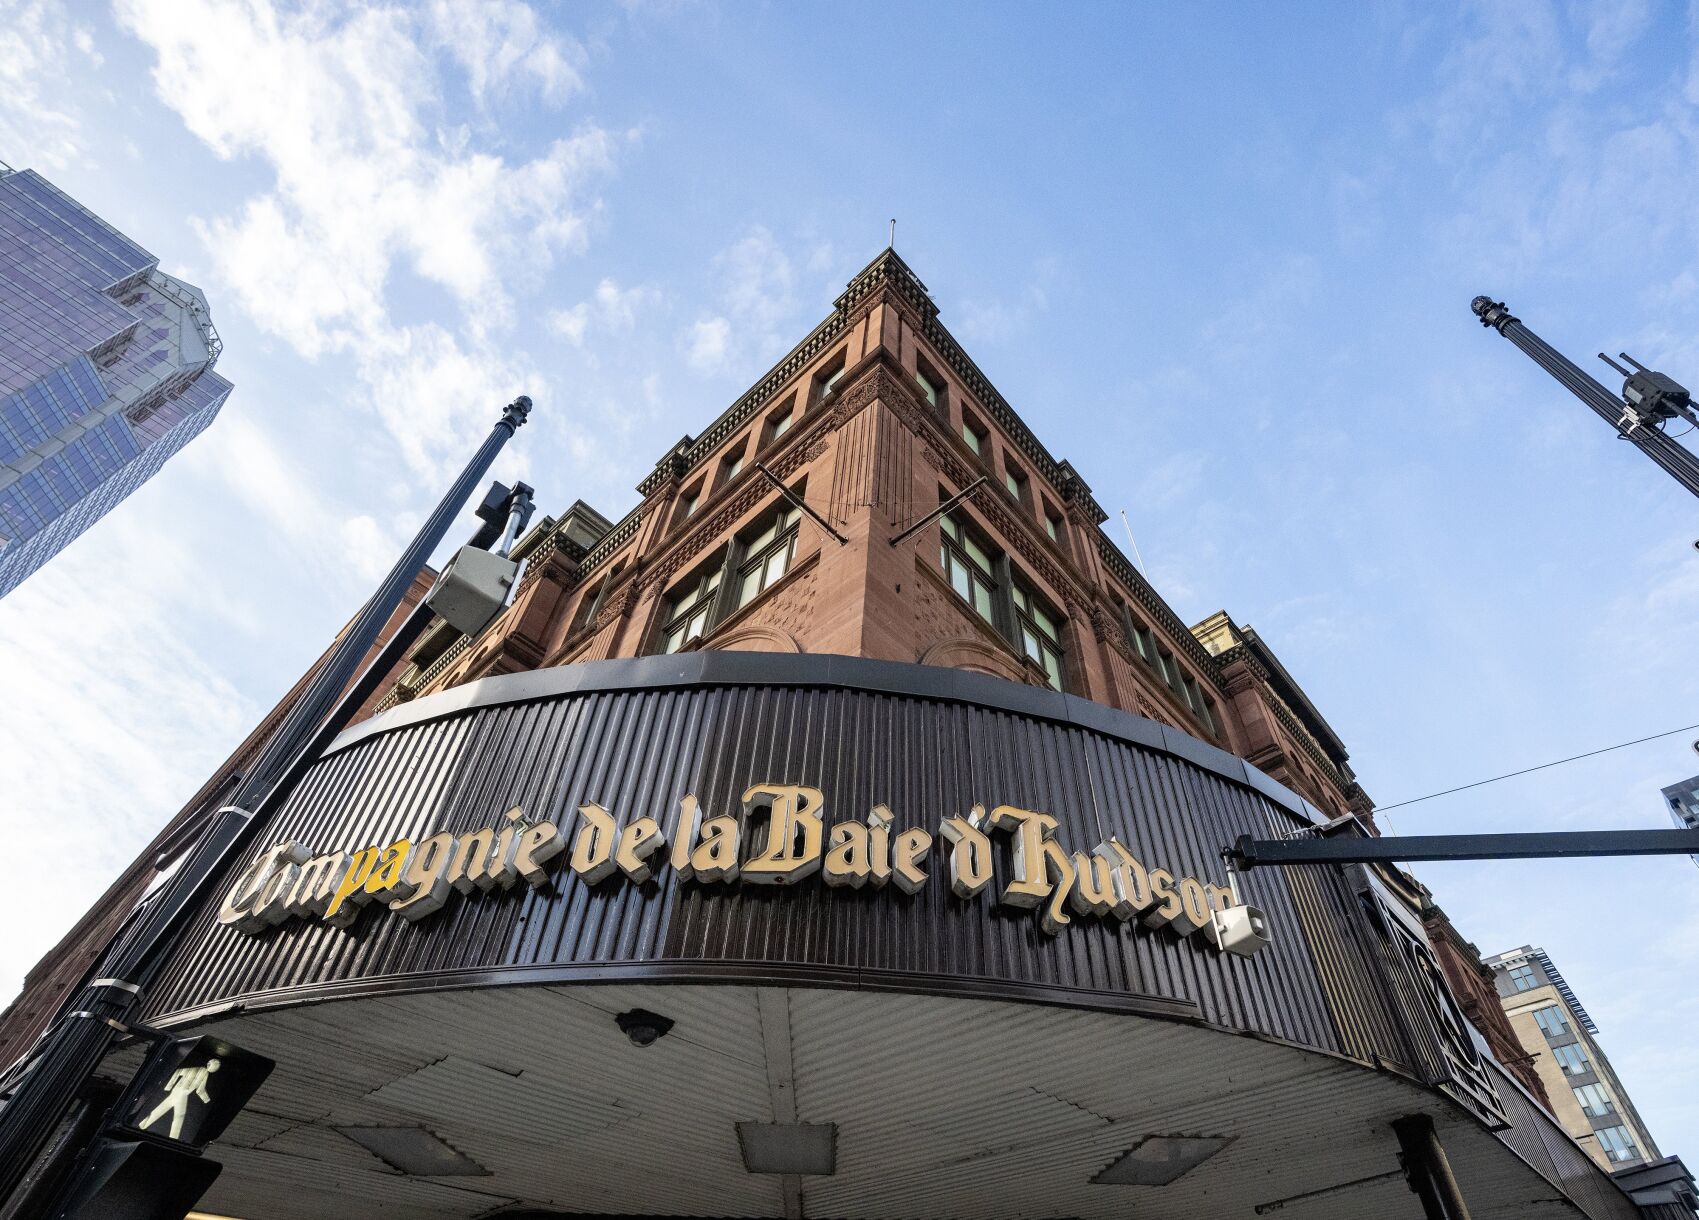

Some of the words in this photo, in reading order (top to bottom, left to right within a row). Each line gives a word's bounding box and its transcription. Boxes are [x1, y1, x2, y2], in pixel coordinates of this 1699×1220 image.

[218, 805, 563, 925] Compagnie
[570, 799, 661, 886] de
[670, 792, 739, 884] la
[741, 783, 933, 888] Baie
